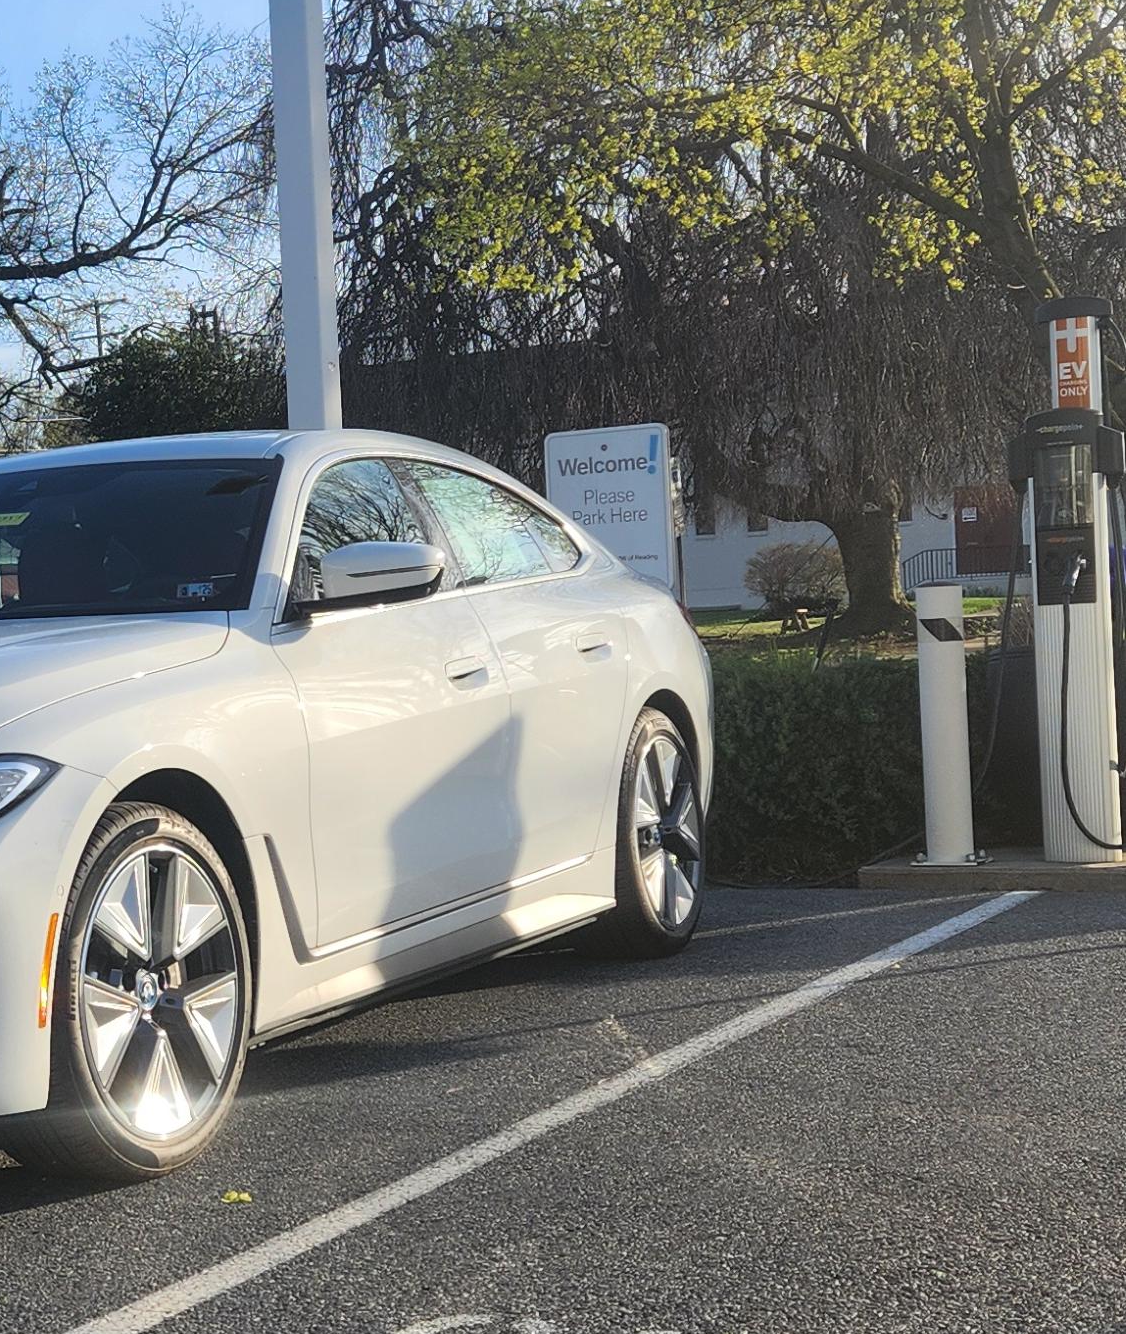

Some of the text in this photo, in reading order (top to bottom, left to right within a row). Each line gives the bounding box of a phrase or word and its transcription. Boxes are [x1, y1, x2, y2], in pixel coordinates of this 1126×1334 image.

[1059, 361, 1087, 379] EV
[1059, 379, 1088, 387] CHARGING
[1060, 385, 1089, 397] ONLY
[557, 435, 659, 476] Welcome!
[584, 489, 635, 505] Please
[571, 507, 648, 525] Park Here
